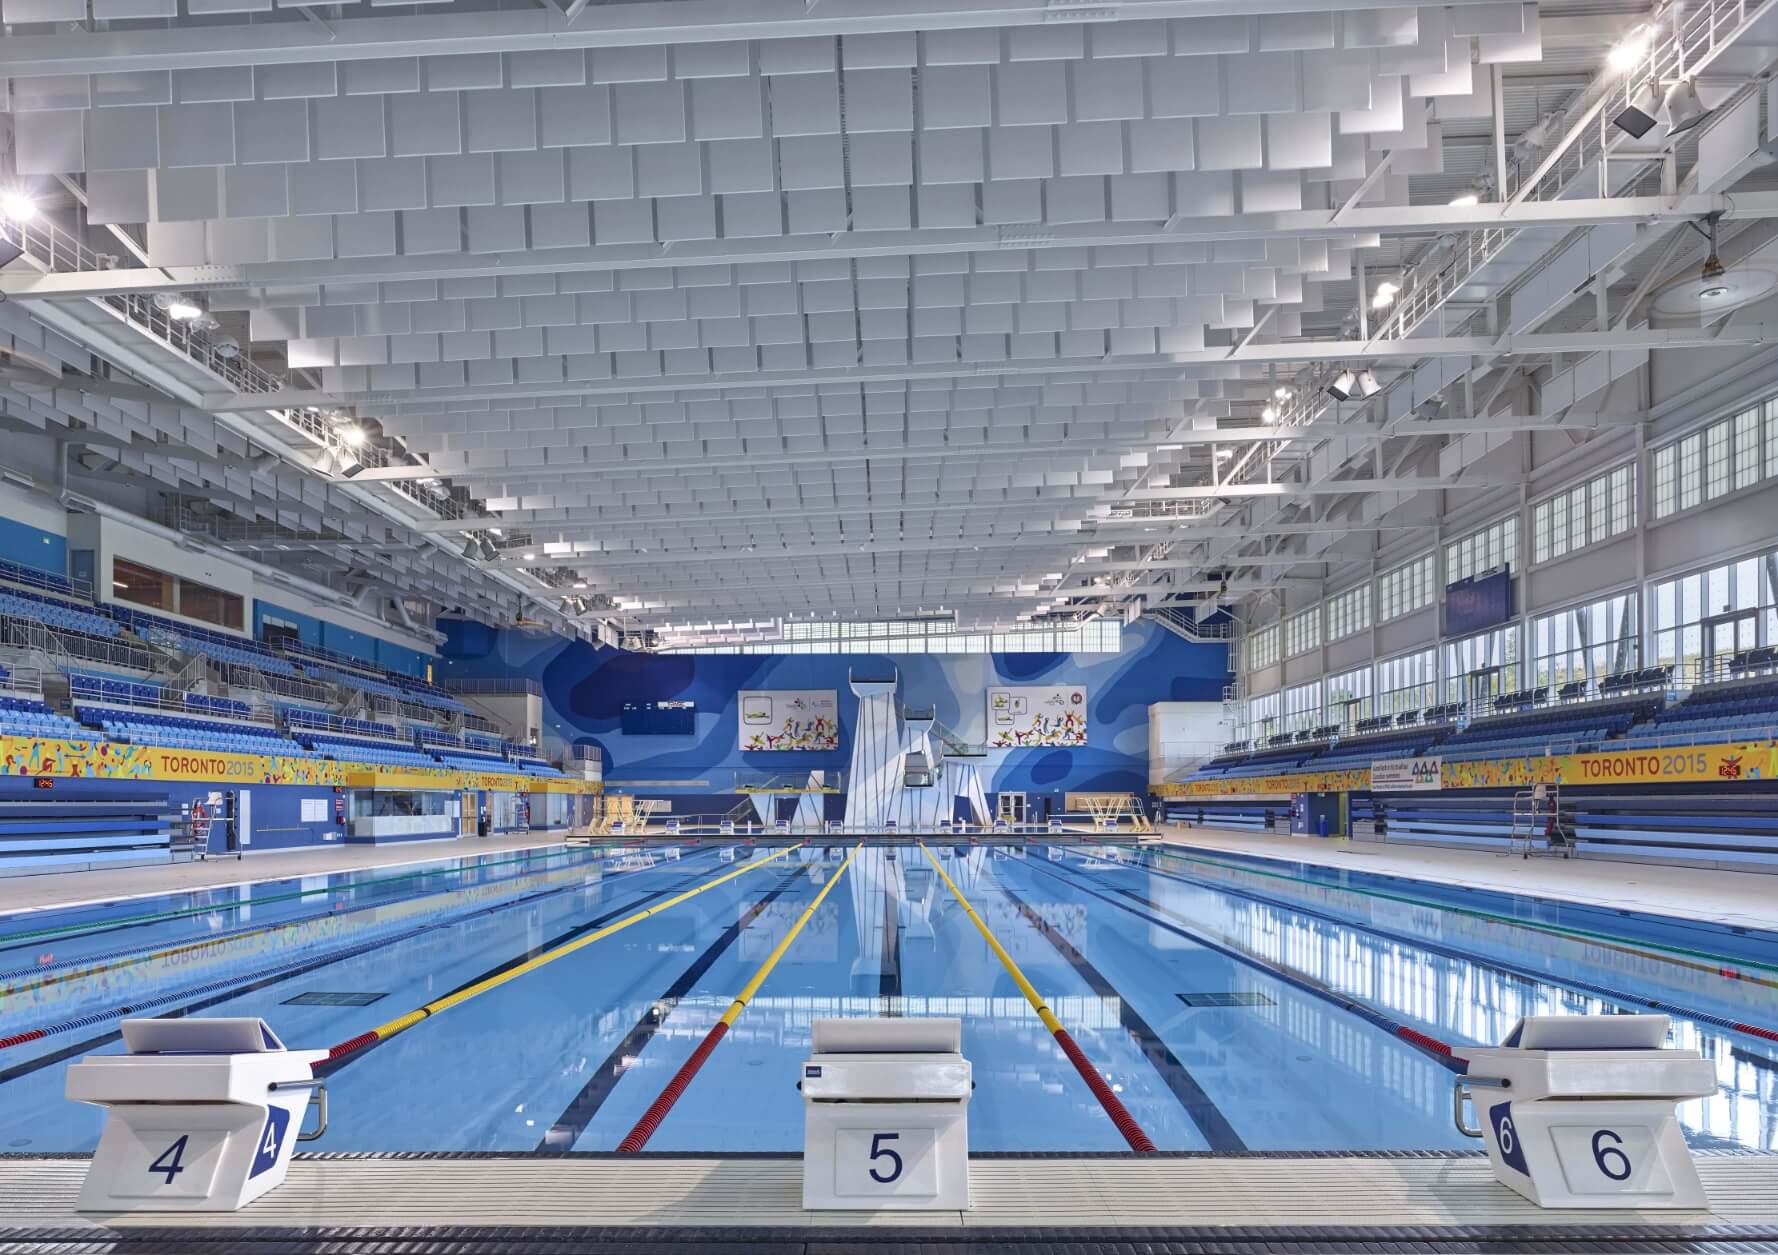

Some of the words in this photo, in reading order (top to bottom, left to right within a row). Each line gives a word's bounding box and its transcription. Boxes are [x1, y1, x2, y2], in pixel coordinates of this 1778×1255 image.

[148, 1135, 189, 1185] 4
[263, 1122, 277, 1159] 4
[869, 1133, 903, 1183] 5
[1500, 1116, 1512, 1155] 6
[1592, 1130, 1632, 1181] 6
